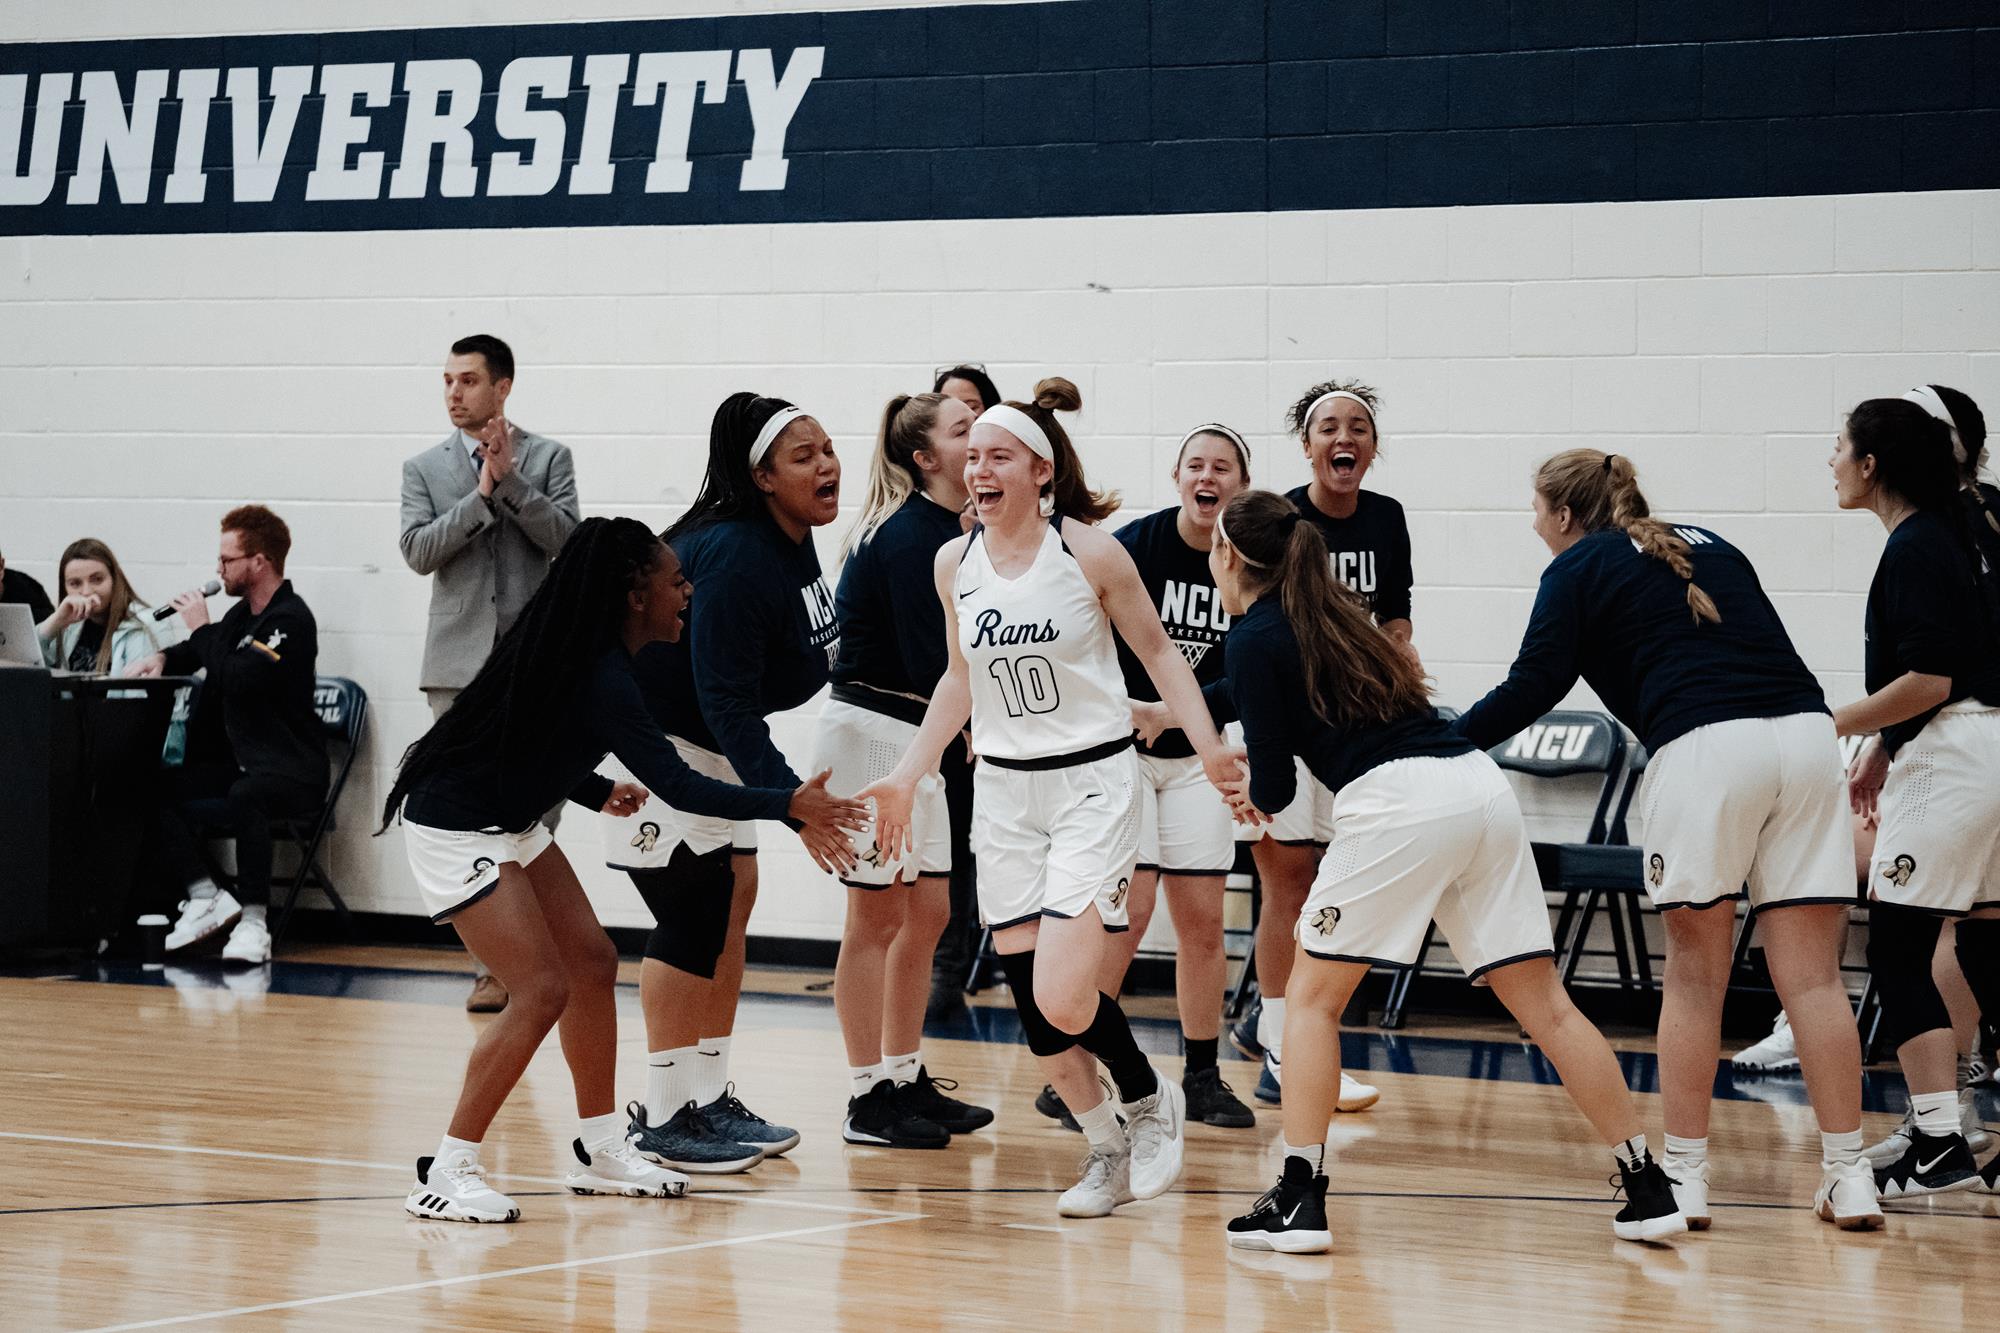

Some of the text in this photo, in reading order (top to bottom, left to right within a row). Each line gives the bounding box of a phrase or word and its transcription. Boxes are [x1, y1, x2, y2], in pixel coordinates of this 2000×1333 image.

[0, 46, 825, 206] UNIVERSITY
[1160, 579, 1231, 631] NCU
[970, 608, 1060, 649] Rams
[1168, 626, 1224, 642] SKETBA
[988, 655, 1060, 718] 10
[1504, 724, 1595, 761] NCU
